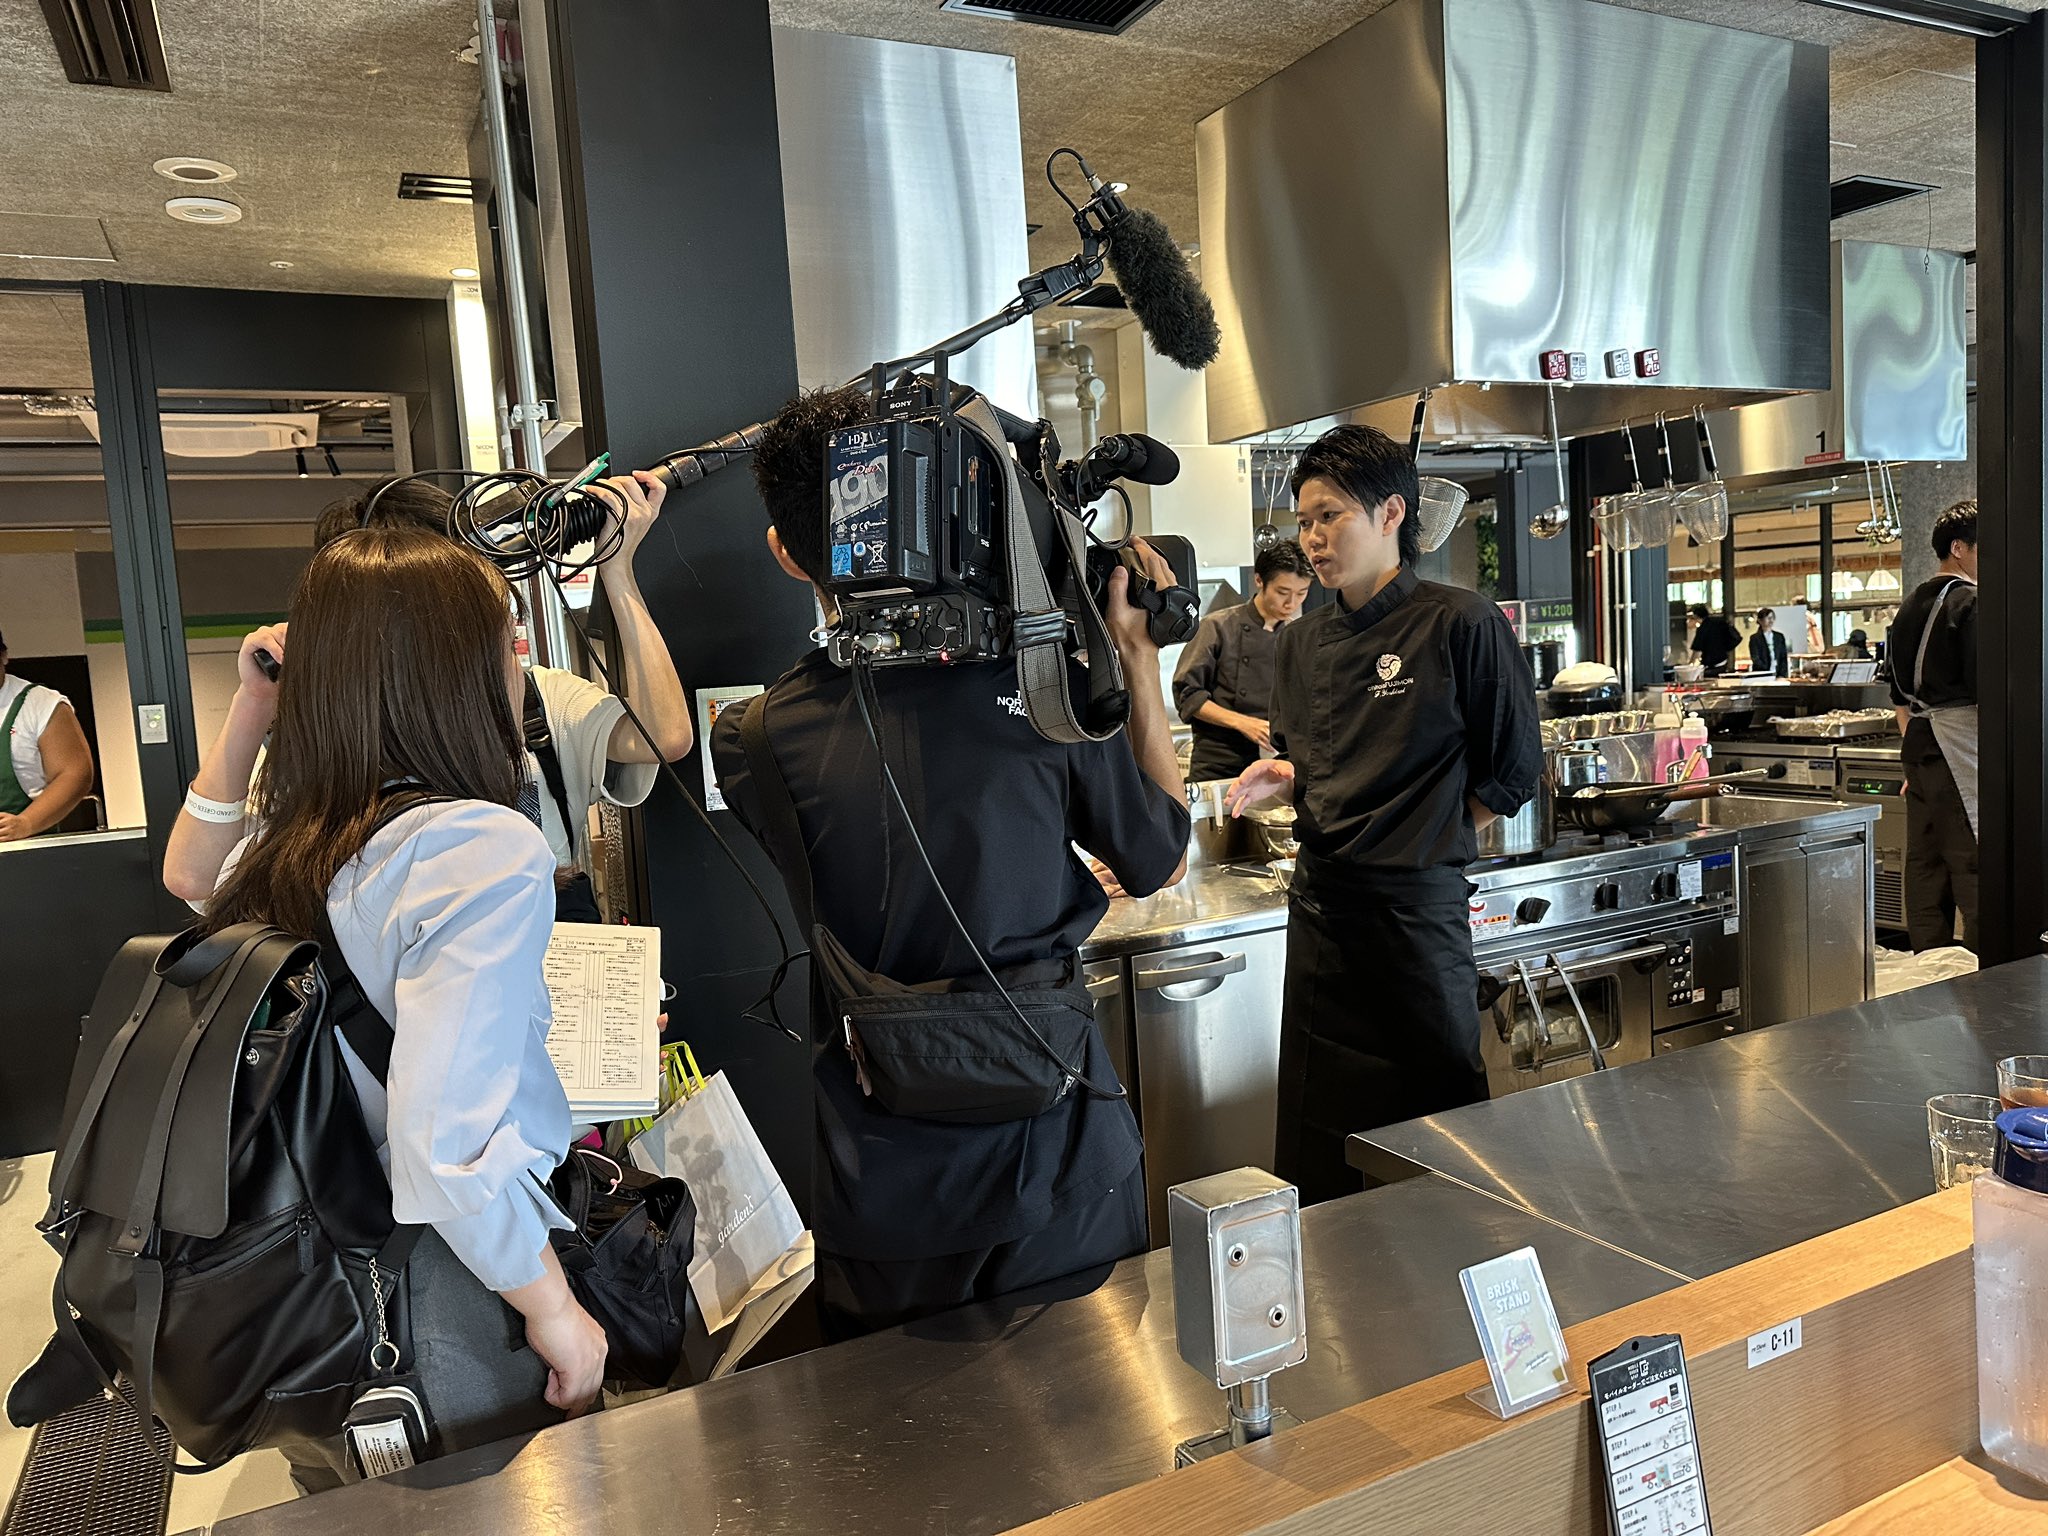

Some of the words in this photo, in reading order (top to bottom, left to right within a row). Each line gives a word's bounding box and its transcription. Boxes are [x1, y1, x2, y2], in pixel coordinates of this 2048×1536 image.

[889, 400, 912, 409] SONY
[1816, 430, 1826, 453] 1
[1541, 603, 1573, 617] ¥1,200
[997, 697, 1022, 707] NOR
[1009, 706, 1028, 716] FAC
[197, 804, 216, 815] GREEN
[216, 809, 237, 817] GRAND
[1487, 1278, 1519, 1299] BRISK
[1496, 1291, 1531, 1313] STAND
[1771, 1326, 1793, 1351] C-11
[1604, 1368, 1677, 1399] モバイルオーダーでご注文ください
